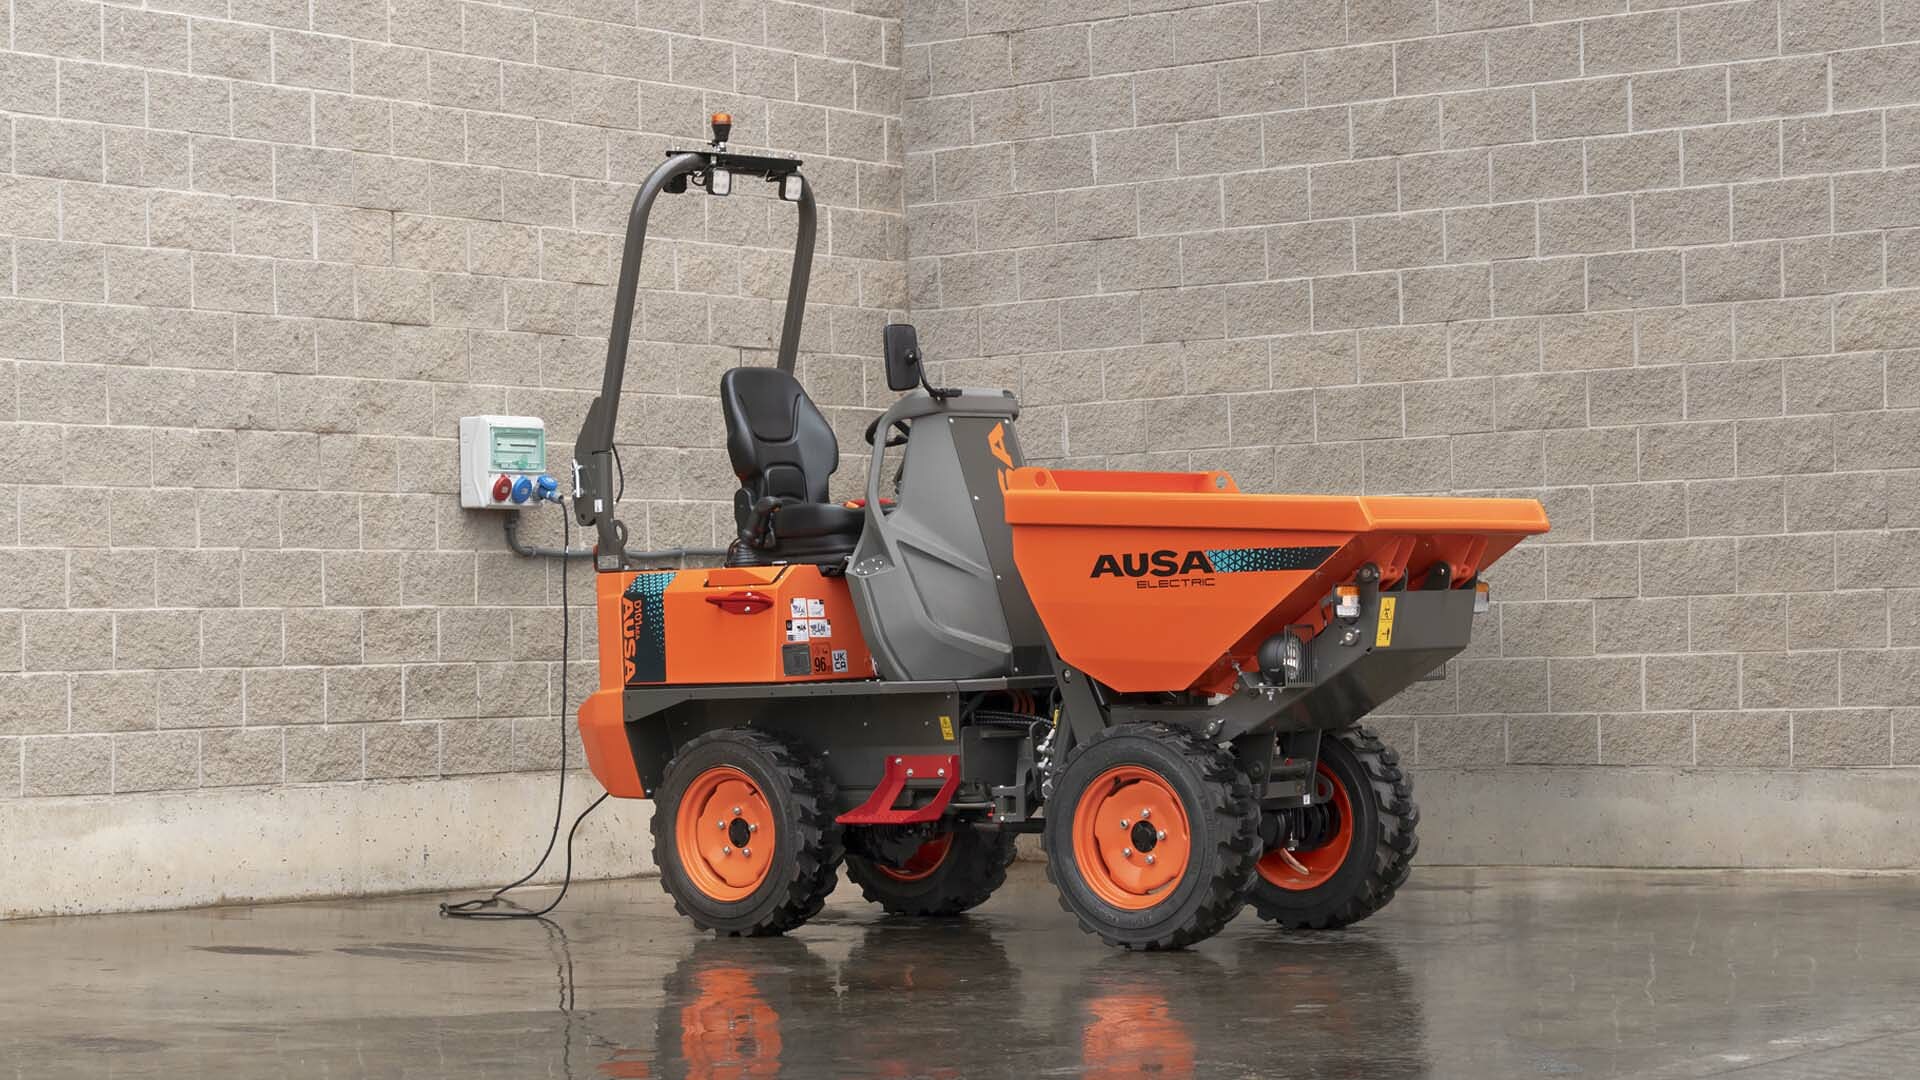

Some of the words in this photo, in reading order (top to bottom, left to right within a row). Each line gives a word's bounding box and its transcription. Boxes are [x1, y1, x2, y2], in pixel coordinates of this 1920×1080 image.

[1090, 550, 1214, 578] AUSA
[1137, 578, 1215, 589] ELECTRIC
[623, 597, 636, 683] AUSA
[833, 653, 845, 661] UK
[814, 657, 826, 672] 96
[834, 661, 846, 670] CA
